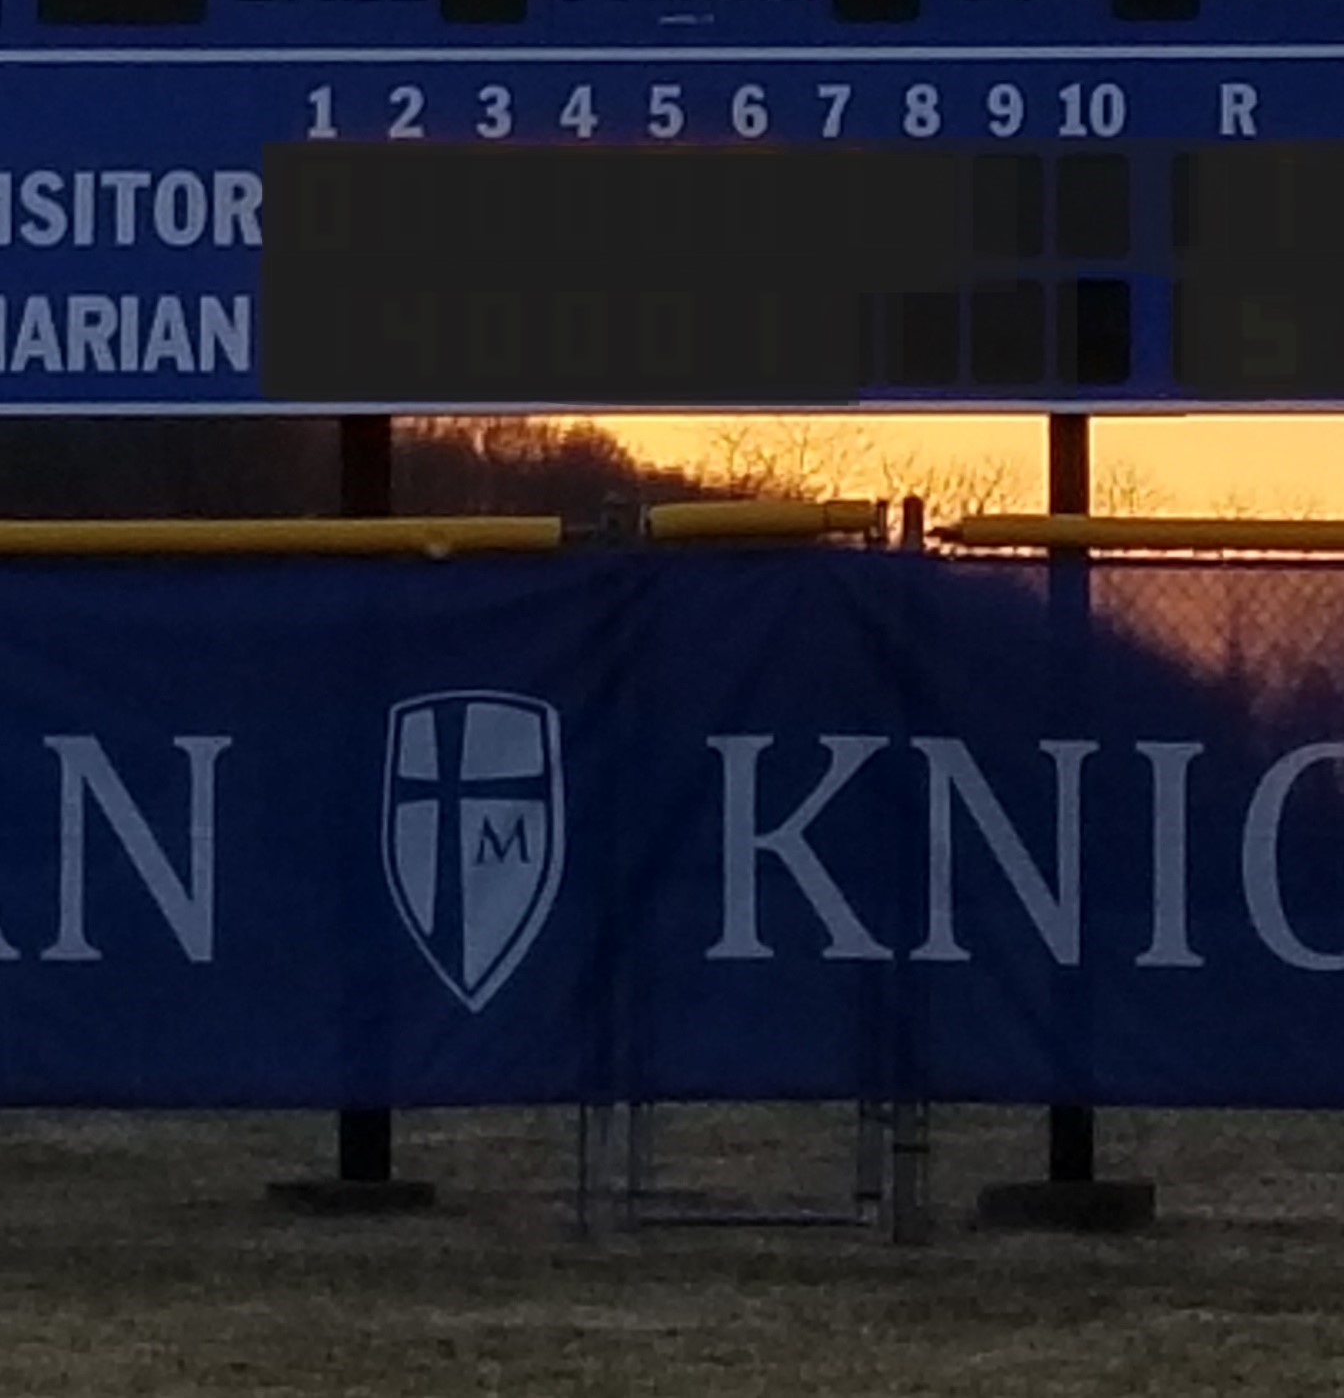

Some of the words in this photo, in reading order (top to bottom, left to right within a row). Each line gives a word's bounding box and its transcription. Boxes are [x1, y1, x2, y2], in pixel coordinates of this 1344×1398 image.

[308, 87, 337, 139] 1
[387, 86, 425, 140] 2
[476, 86, 511, 139] 3
[560, 85, 598, 139] 4
[648, 85, 684, 139] 5
[732, 85, 768, 138] 6
[819, 85, 851, 138] 7
[904, 84, 940, 137] 8
[988, 84, 1023, 137] 9
[1059, 83, 1125, 137] 10
[1221, 83, 1257, 135] R
[475, 814, 531, 864] M
